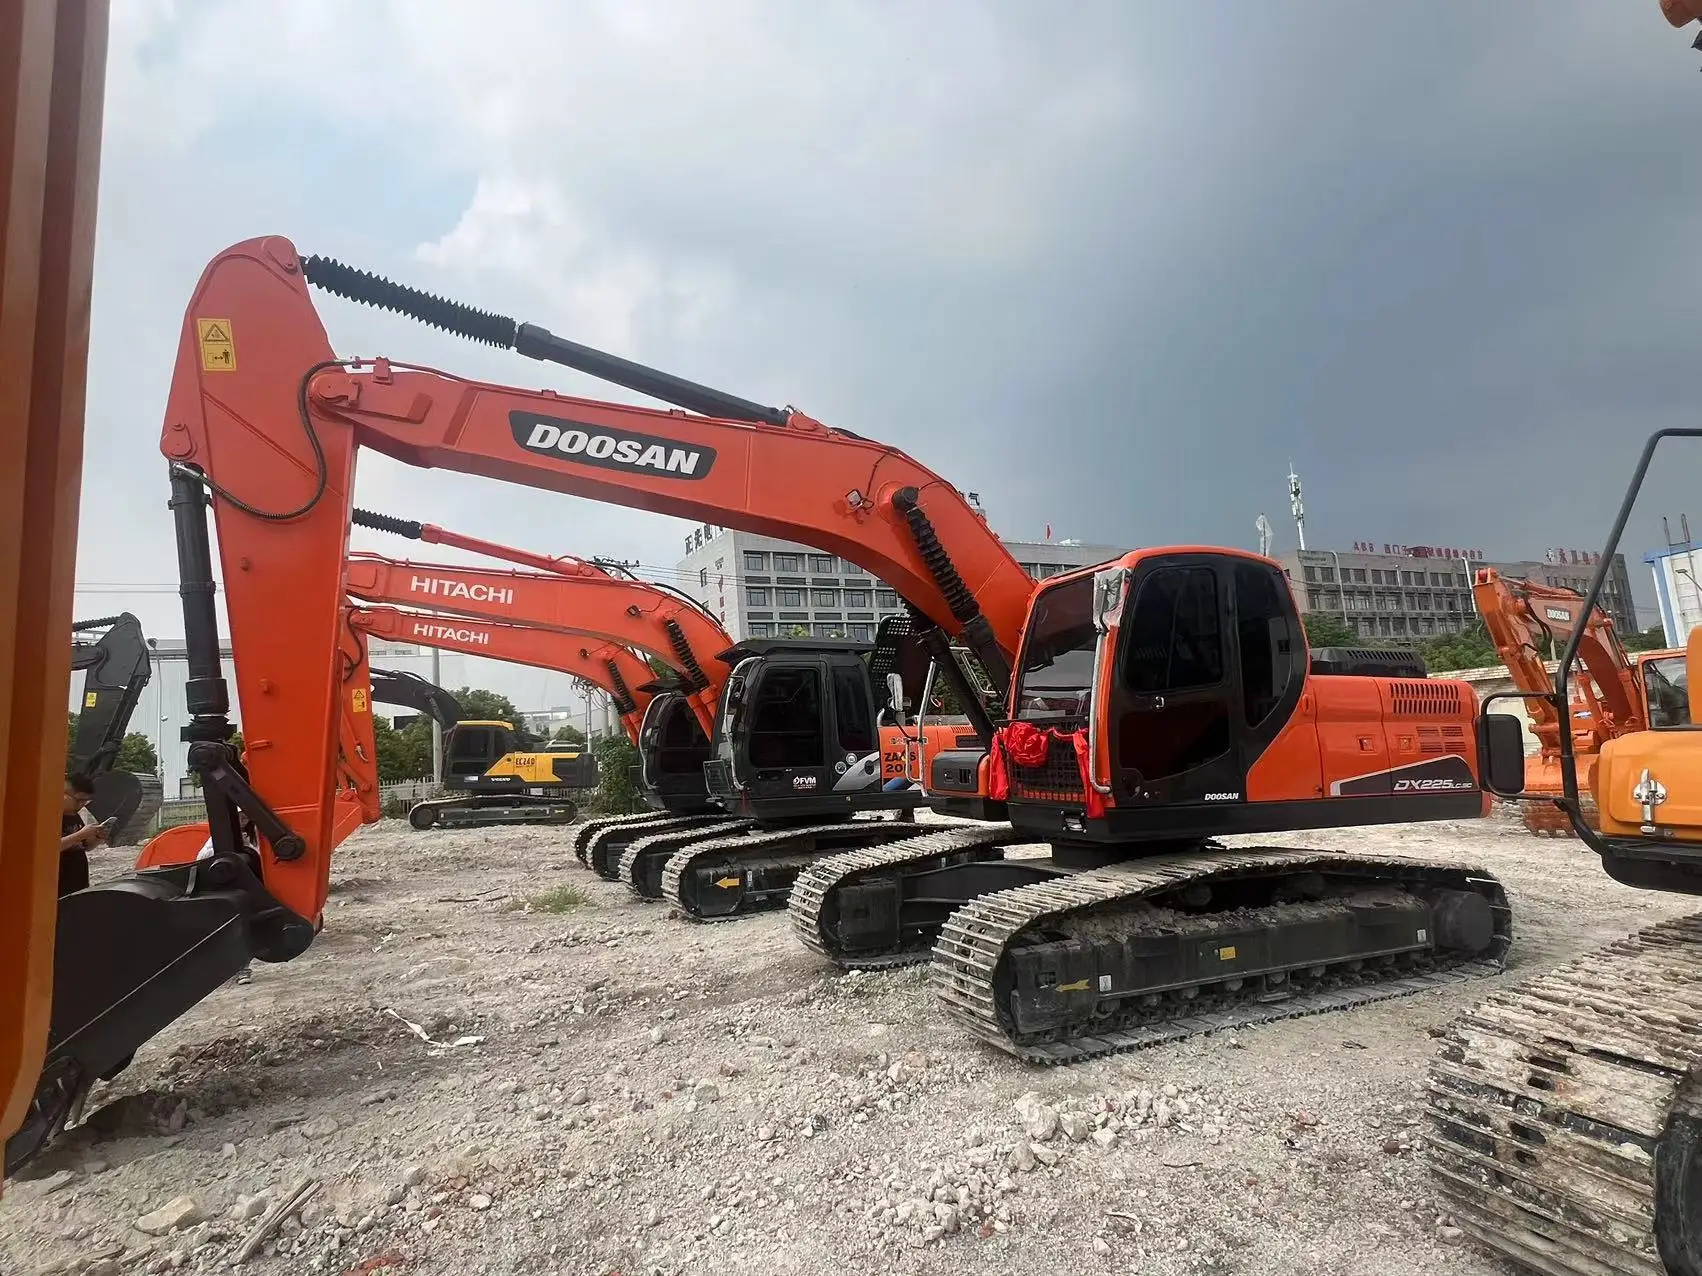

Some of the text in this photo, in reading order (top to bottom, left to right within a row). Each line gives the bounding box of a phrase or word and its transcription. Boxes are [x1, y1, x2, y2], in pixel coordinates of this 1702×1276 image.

[526, 423, 700, 475] DOOSAN
[410, 575, 514, 604] HITACHI
[413, 623, 489, 644] HITACHI
[1204, 792, 1239, 801] DOOSAN
